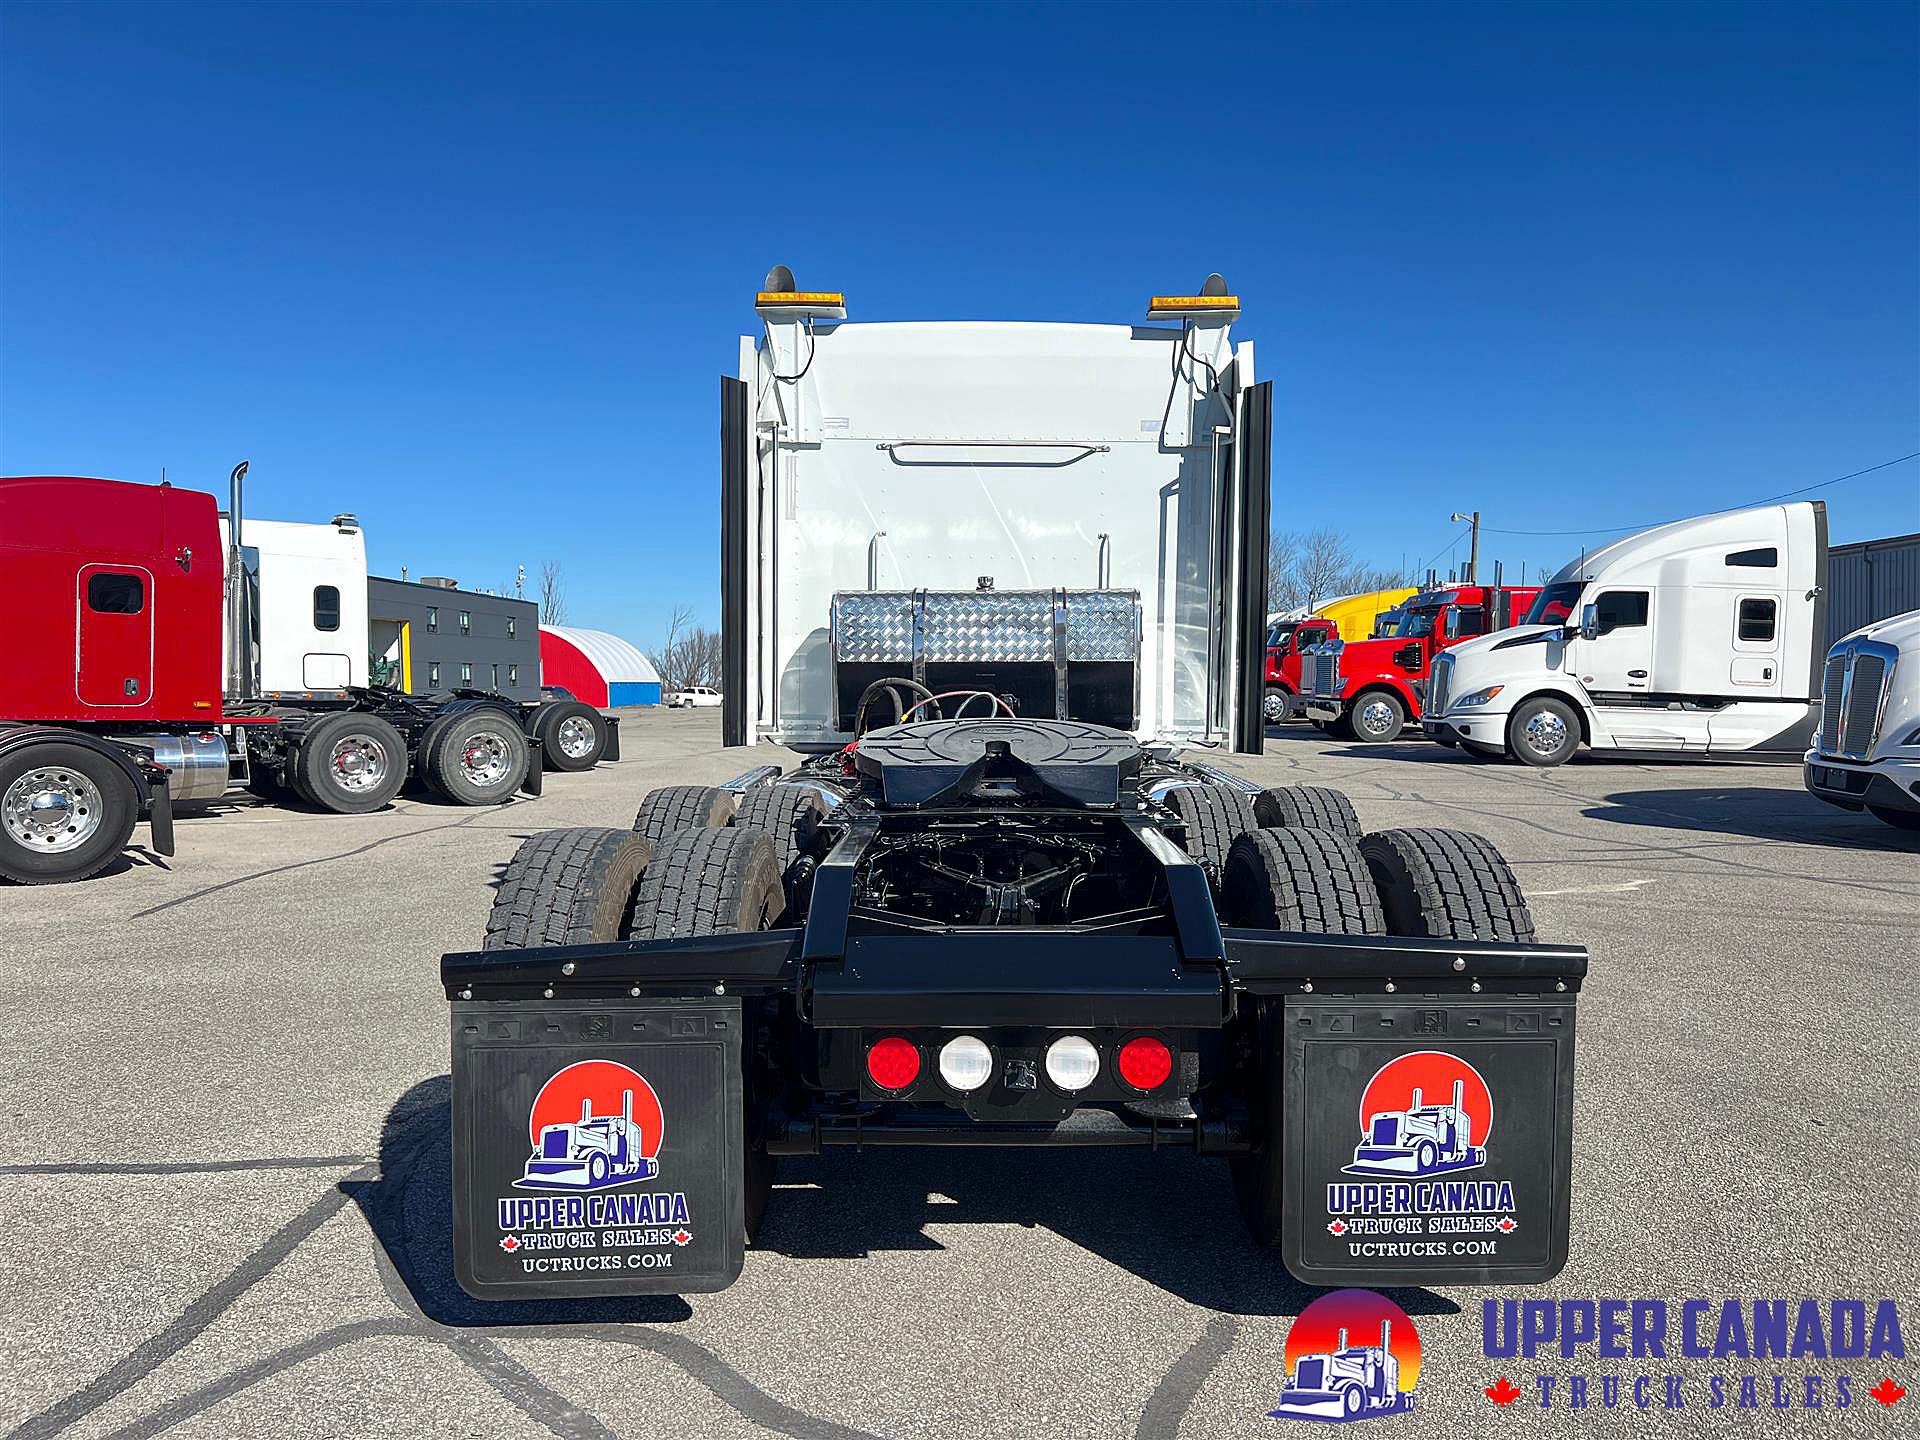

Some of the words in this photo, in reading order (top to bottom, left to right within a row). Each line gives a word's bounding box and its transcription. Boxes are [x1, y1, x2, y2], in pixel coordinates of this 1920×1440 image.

[1327, 1183, 1412, 1215] UPPER
[1414, 1181, 1516, 1213] CANADA
[498, 1196, 585, 1230] UPPER
[587, 1192, 691, 1228] CANADA
[1350, 1217, 1422, 1235] TRUCK
[1428, 1216, 1497, 1234] SALES
[521, 1232, 596, 1250] TRUCK
[602, 1228, 672, 1247] SALES
[1349, 1241, 1497, 1257] UCTRUCKS.COM
[522, 1253, 673, 1273] UCTRUCKS.COM
